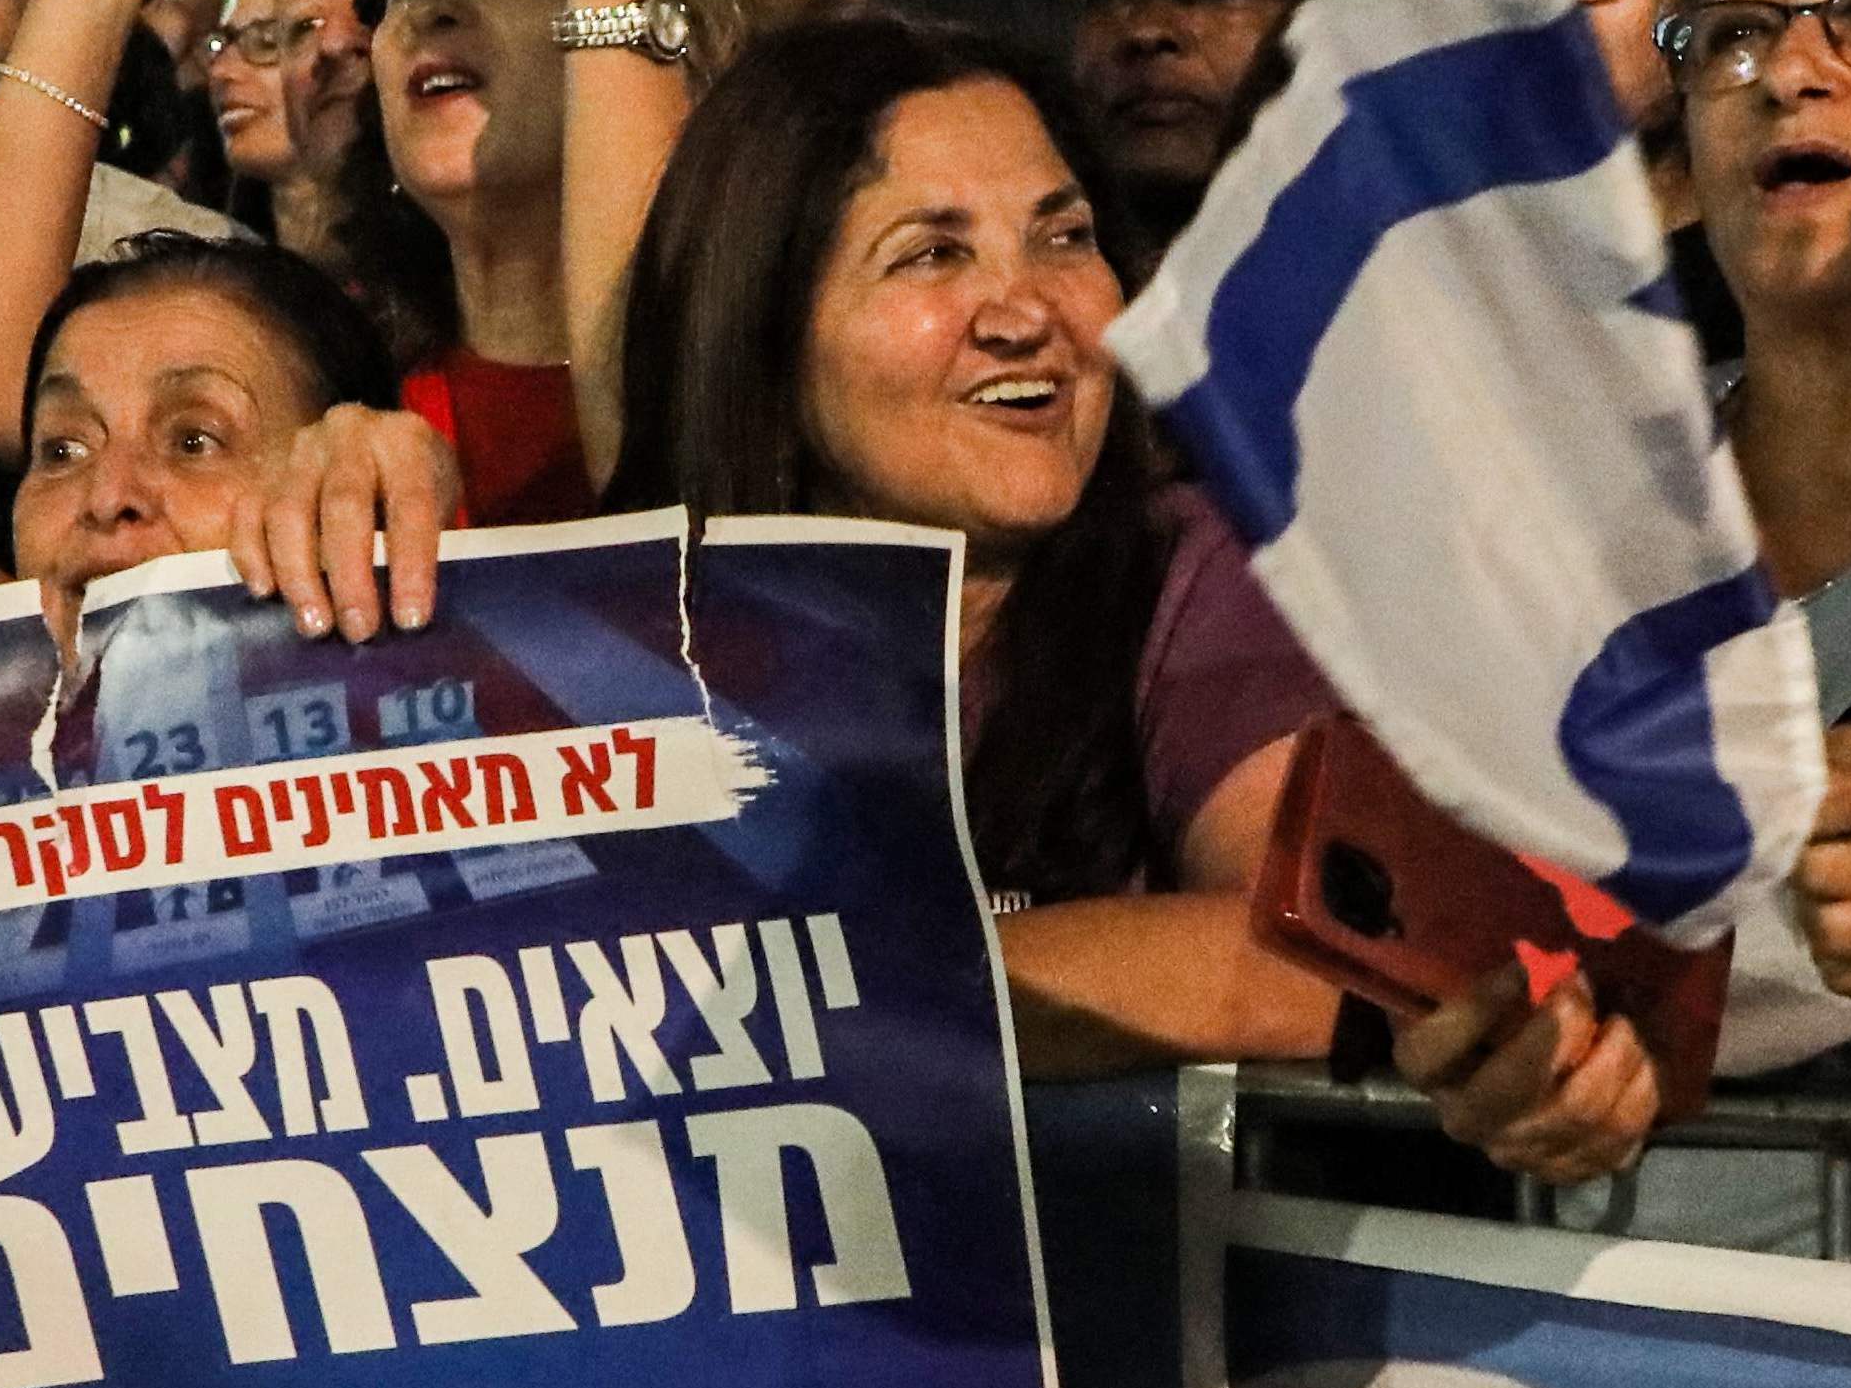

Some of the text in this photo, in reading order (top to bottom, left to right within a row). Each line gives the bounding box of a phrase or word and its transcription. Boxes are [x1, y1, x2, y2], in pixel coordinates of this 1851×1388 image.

[124, 723, 207, 779] 23
[263, 699, 338, 760] 13
[557, 727, 657, 816] לא
[214, 753, 538, 858] מאמינים
[405, 912, 860, 1123] יוצאים.
